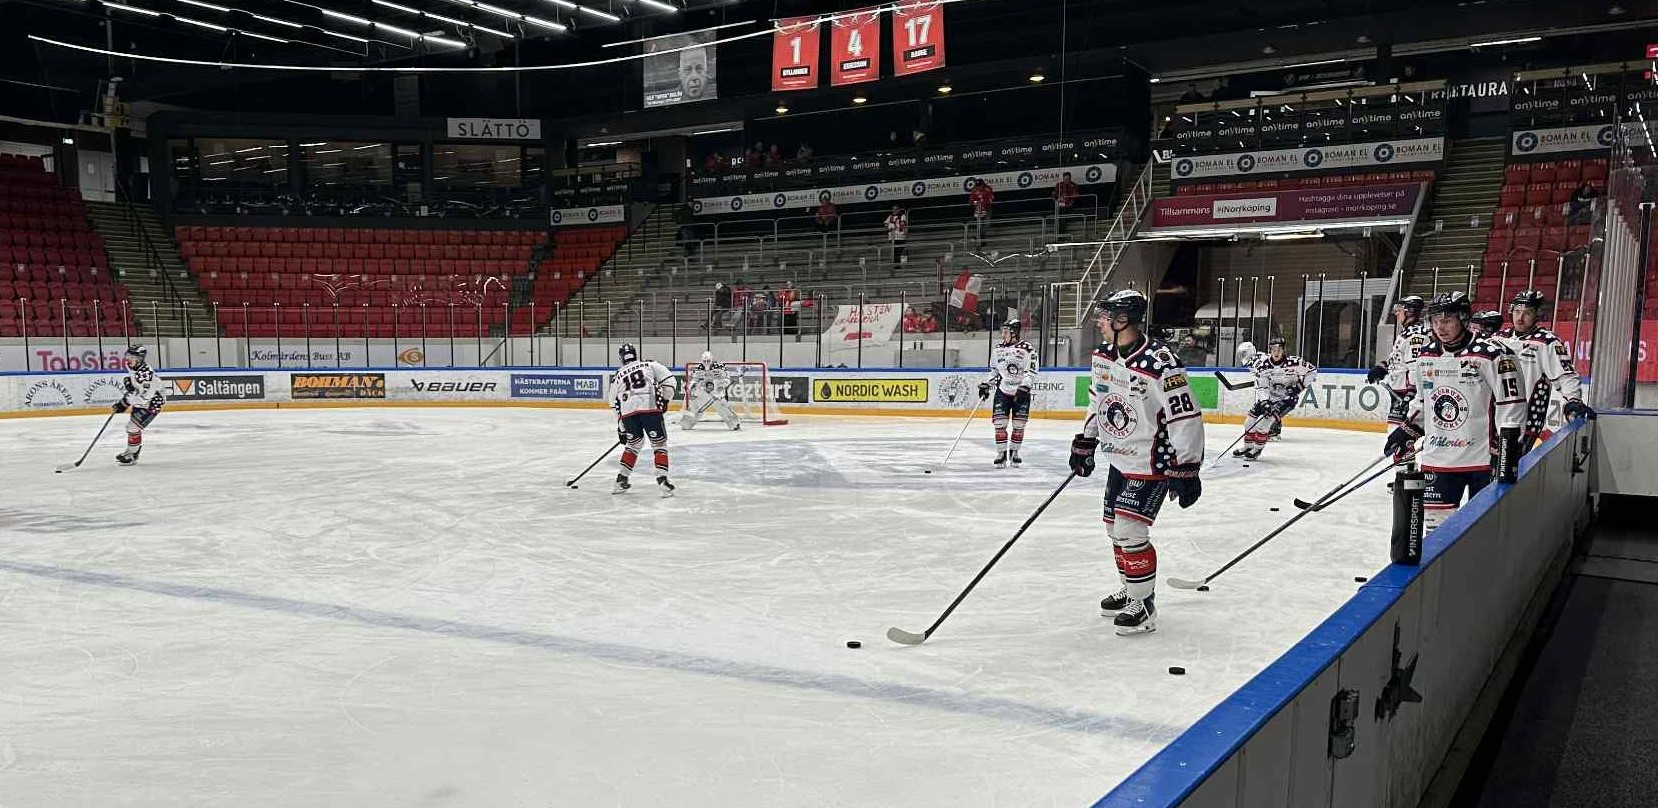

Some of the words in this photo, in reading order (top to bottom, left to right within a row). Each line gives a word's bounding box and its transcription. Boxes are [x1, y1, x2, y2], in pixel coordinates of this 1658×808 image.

[905, 15, 931, 46] 17
[790, 36, 802, 63] 1
[848, 29, 862, 57] 4
[457, 119, 530, 138] SLÄTTÖ
[1160, 207, 1211, 216] Tillsammans
[313, 351, 333, 362] Buss
[336, 351, 351, 362] AB
[198, 380, 261, 397] Saltängen
[427, 381, 497, 392] BAUER
[514, 377, 572, 386] HÄSTKRAFTERNA
[575, 380, 598, 390] MABI
[622, 368, 647, 392] 18
[1501, 378, 1519, 398] 15
[549, 387, 568, 395] FRÅN
[836, 385, 879, 397] NORDIC
[882, 385, 918, 397] WASH
[1168, 392, 1194, 416] 28
[1500, 437, 1508, 472] INTERSPORT
[1409, 497, 1420, 549] INTERSPORT
